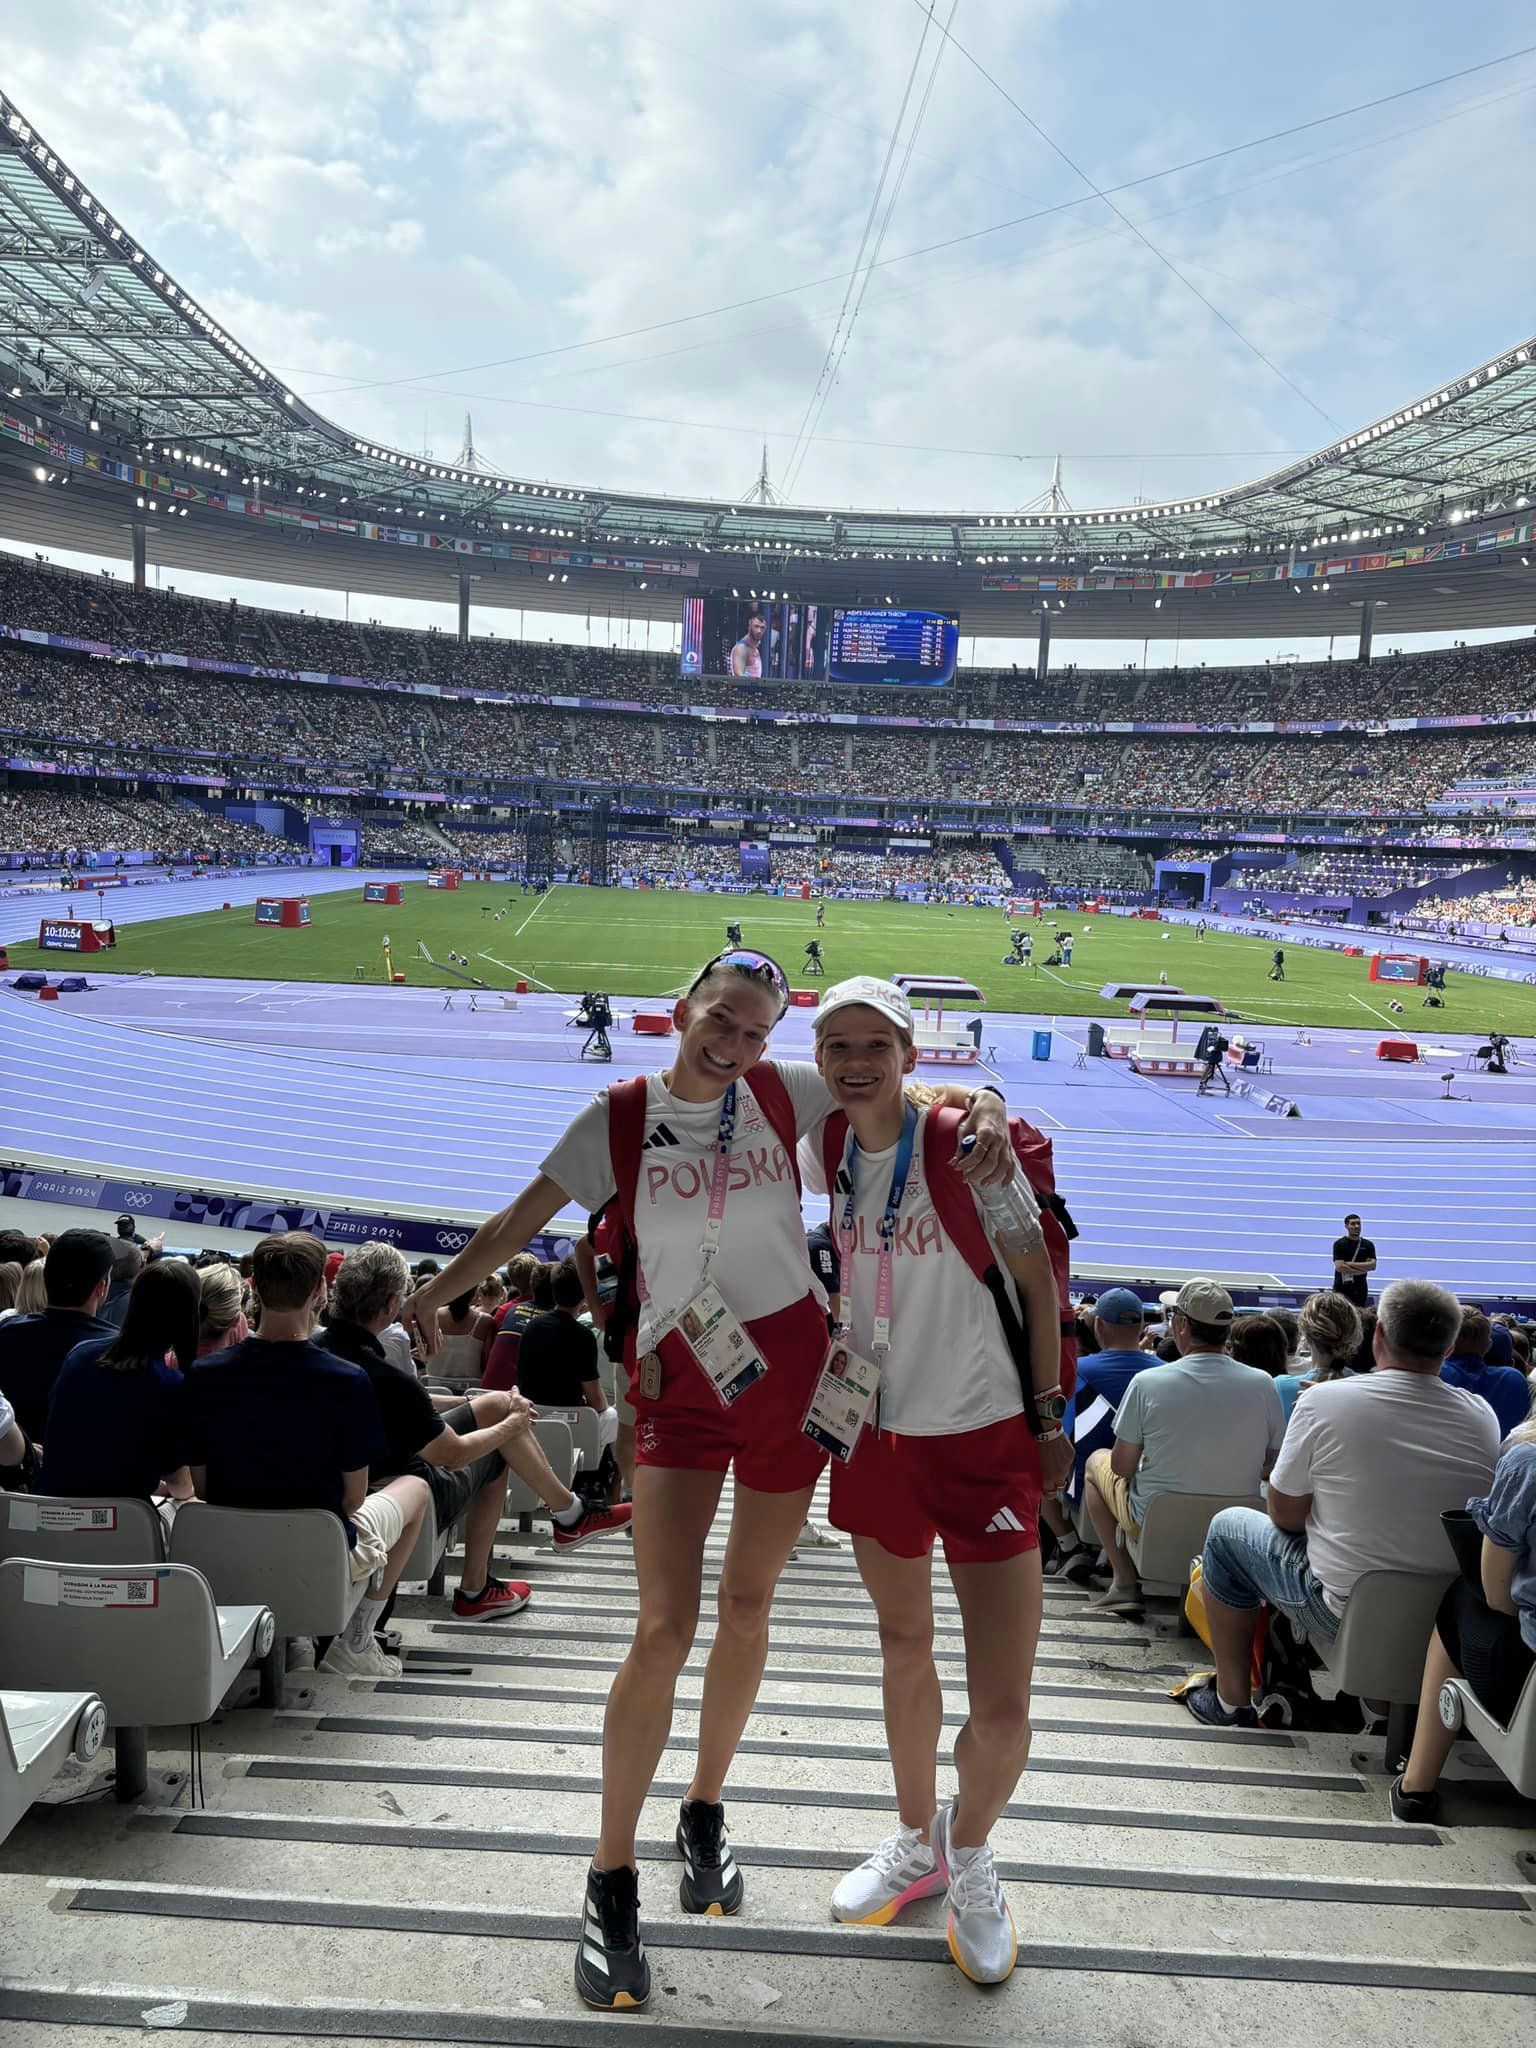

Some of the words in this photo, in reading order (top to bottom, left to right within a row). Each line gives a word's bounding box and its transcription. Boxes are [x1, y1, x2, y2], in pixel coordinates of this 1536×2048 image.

[45, 926, 81, 938] 10:10:54
[647, 1144, 792, 1205] POLSKA
[36, 1182, 66, 1194] PARIS
[68, 1186, 97, 1198] 2024
[334, 1222, 368, 1234] PARIS
[371, 1226, 403, 1239] 2024
